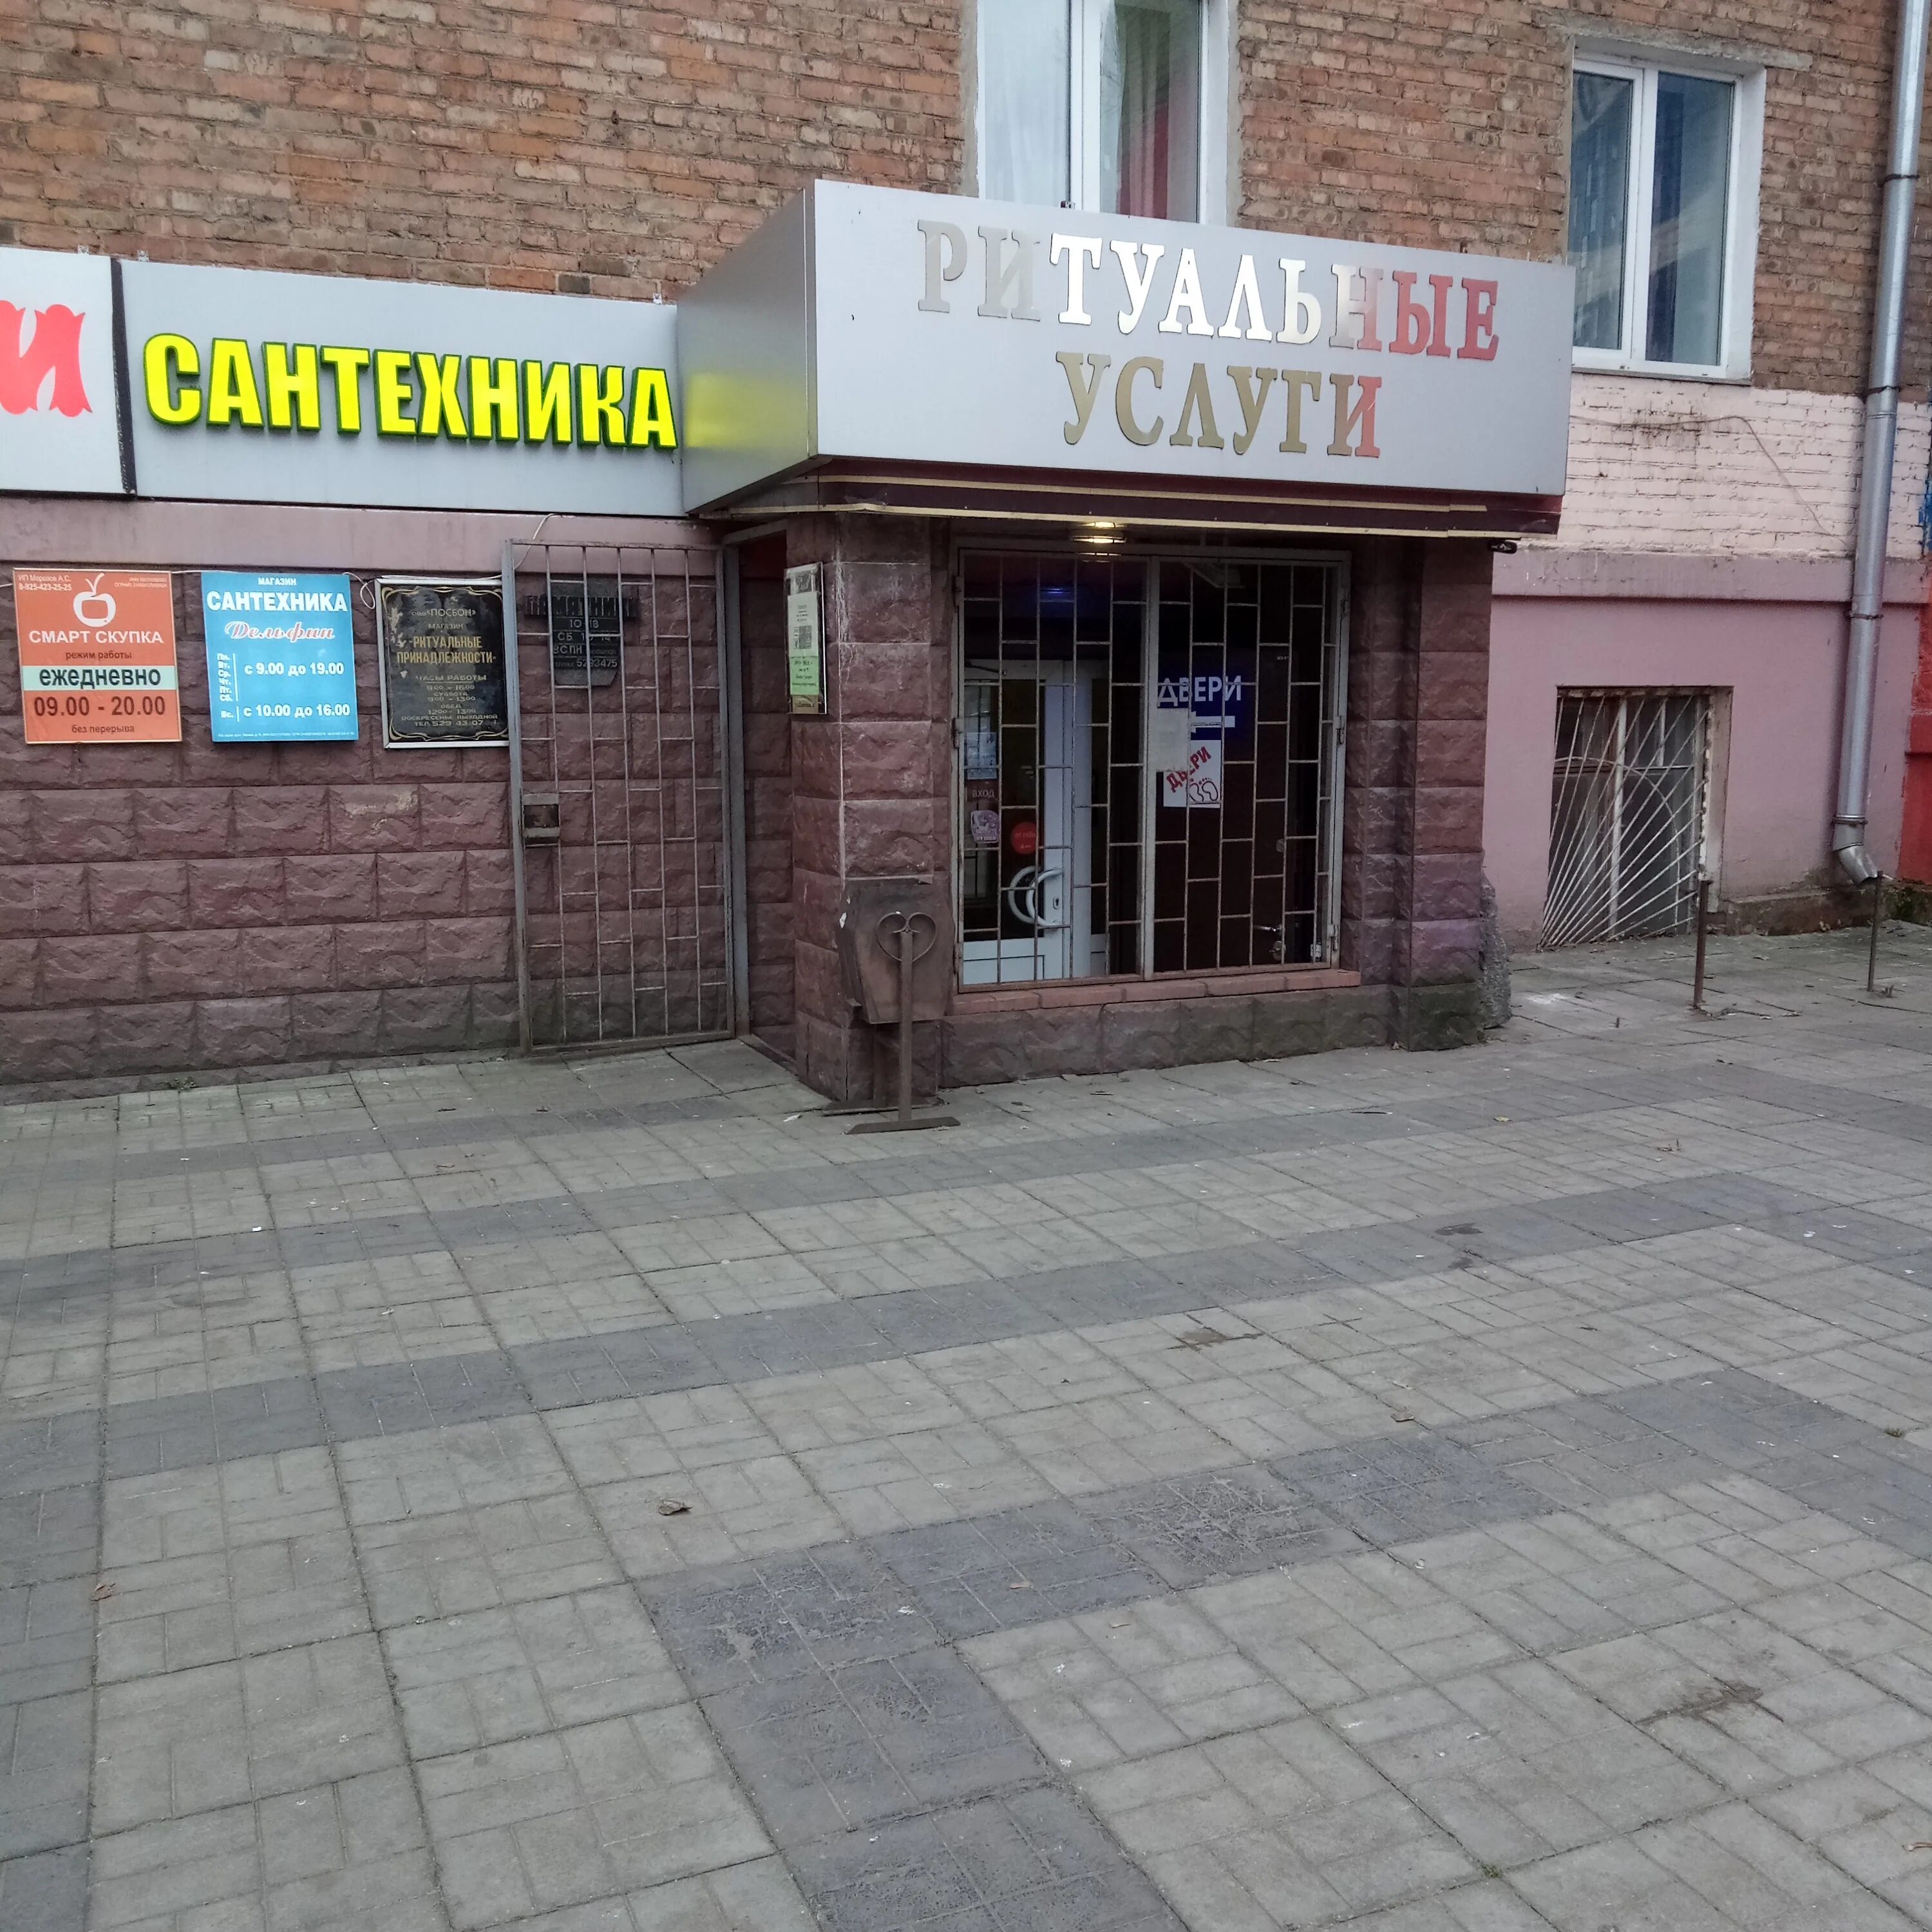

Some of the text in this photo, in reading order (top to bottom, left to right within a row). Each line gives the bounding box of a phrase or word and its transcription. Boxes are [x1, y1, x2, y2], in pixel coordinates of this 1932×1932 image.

[917, 219, 1499, 361] РИТУАЛЬНЫЕ
[142, 332, 678, 450] САНТЕХНИКА
[1056, 351, 1383, 458] УСЛУГИ
[258, 577, 297, 586] МАГАЗИН
[207, 591, 348, 612] САНТЕХНИКА
[29, 630, 164, 643] СМАРТ СКУПКА
[225, 620, 336, 643] Дельфин
[66, 650, 132, 661] режим работы
[39, 668, 161, 689] ежедневно
[256, 662, 284, 674] 9.00
[288, 664, 307, 676] до
[310, 662, 345, 674] 19.00
[1158, 676, 1242, 706] ДВЕРИ
[34, 696, 90, 716] 09.00
[111, 696, 166, 715] 20.00
[256, 704, 290, 716] 10.00
[294, 706, 313, 718] до
[316, 704, 350, 716] 16.00
[71, 724, 135, 734] без перерыва
[1166, 746, 1211, 793] ДВРИ
[972, 790, 995, 799] ВХОД
